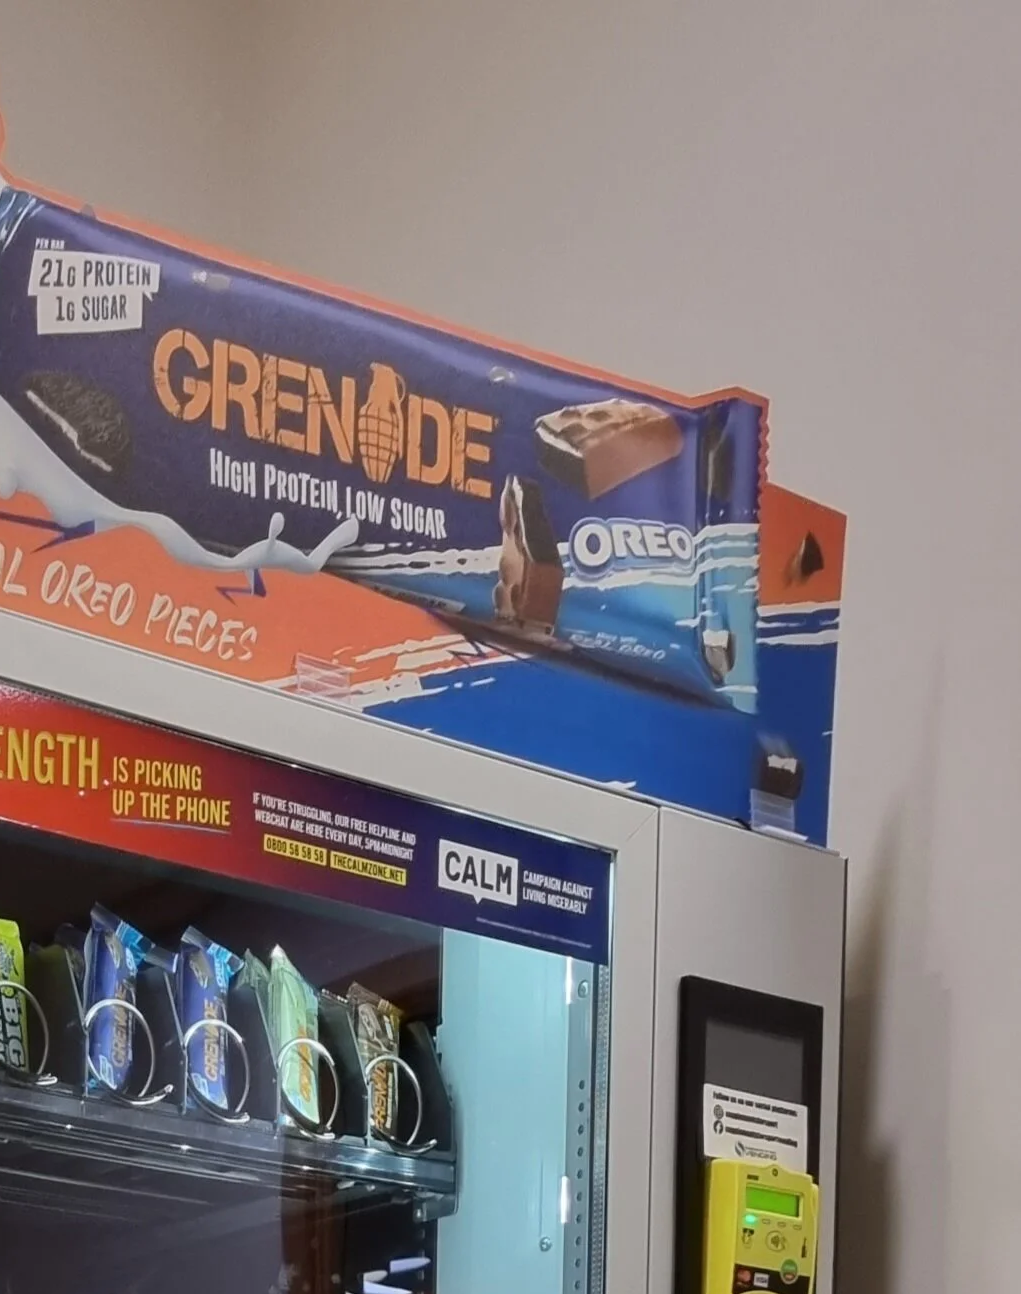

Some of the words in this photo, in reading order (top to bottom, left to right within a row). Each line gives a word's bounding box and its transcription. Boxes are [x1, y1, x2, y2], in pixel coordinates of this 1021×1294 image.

[83, 260, 151, 287] PROTEIN
[82, 295, 127, 321] SUGAR
[209, 448, 256, 498] HIGH
[345, 486, 384, 521] LOW
[390, 497, 447, 540] SUGAR
[574, 523, 695, 567] OREO
[41, 563, 136, 627] OREO
[144, 592, 259, 662] PIECES
[112, 756, 129, 784] IS
[134, 758, 202, 791] PICKING
[112, 788, 135, 816] UP
[140, 791, 171, 820] THE
[176, 796, 231, 826] PHONE
[252, 792, 260, 805] IF
[334, 813, 350, 828] OUR
[350, 817, 368, 834] FREE
[368, 822, 401, 842] HELPLINE
[401, 831, 416, 846] AND
[255, 809, 289, 828] WEBCHAT
[290, 819, 304, 834] ARE
[306, 823, 324, 839] HERE
[325, 828, 348, 844] EVERY
[266, 837, 287, 850] 0800
[289, 842, 300, 856] 58
[301, 846, 312, 860] 58
[314, 849, 324, 864] 58
[444, 850, 513, 896] CALM
[523, 870, 561, 892] CAMPAIGN
[562, 878, 592, 900] AGAINST
[522, 887, 546, 905] LIVING
[547, 894, 587, 914] MISERABLY
[2, 997, 26, 1068] BIG
